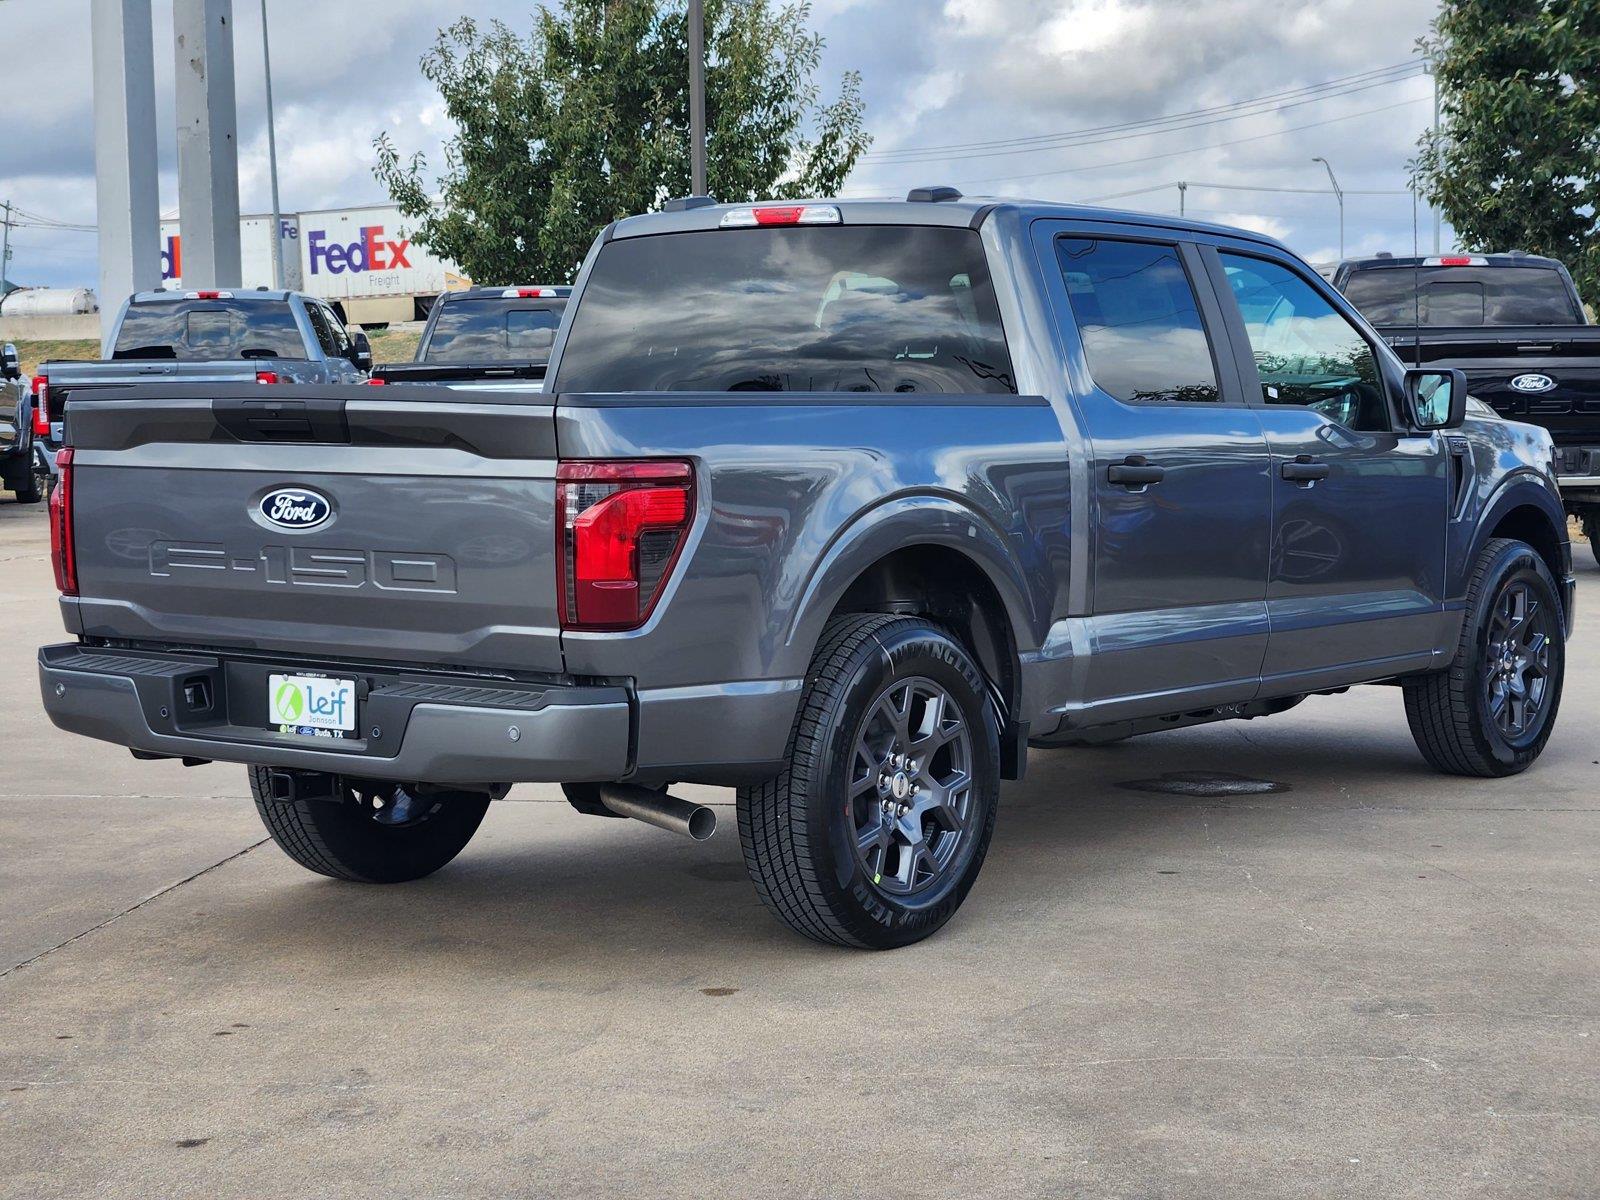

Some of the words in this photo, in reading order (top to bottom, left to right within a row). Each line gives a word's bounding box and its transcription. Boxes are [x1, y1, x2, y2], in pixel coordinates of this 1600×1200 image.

[308, 226, 412, 275] FedEx
[369, 274, 400, 286] Freight
[1519, 376, 1545, 389] Ford
[271, 494, 316, 522] Ford
[150, 539, 458, 594] F-150
[306, 686, 348, 725] leif
[309, 715, 337, 725] Johnson
[334, 730, 343, 738] TX
